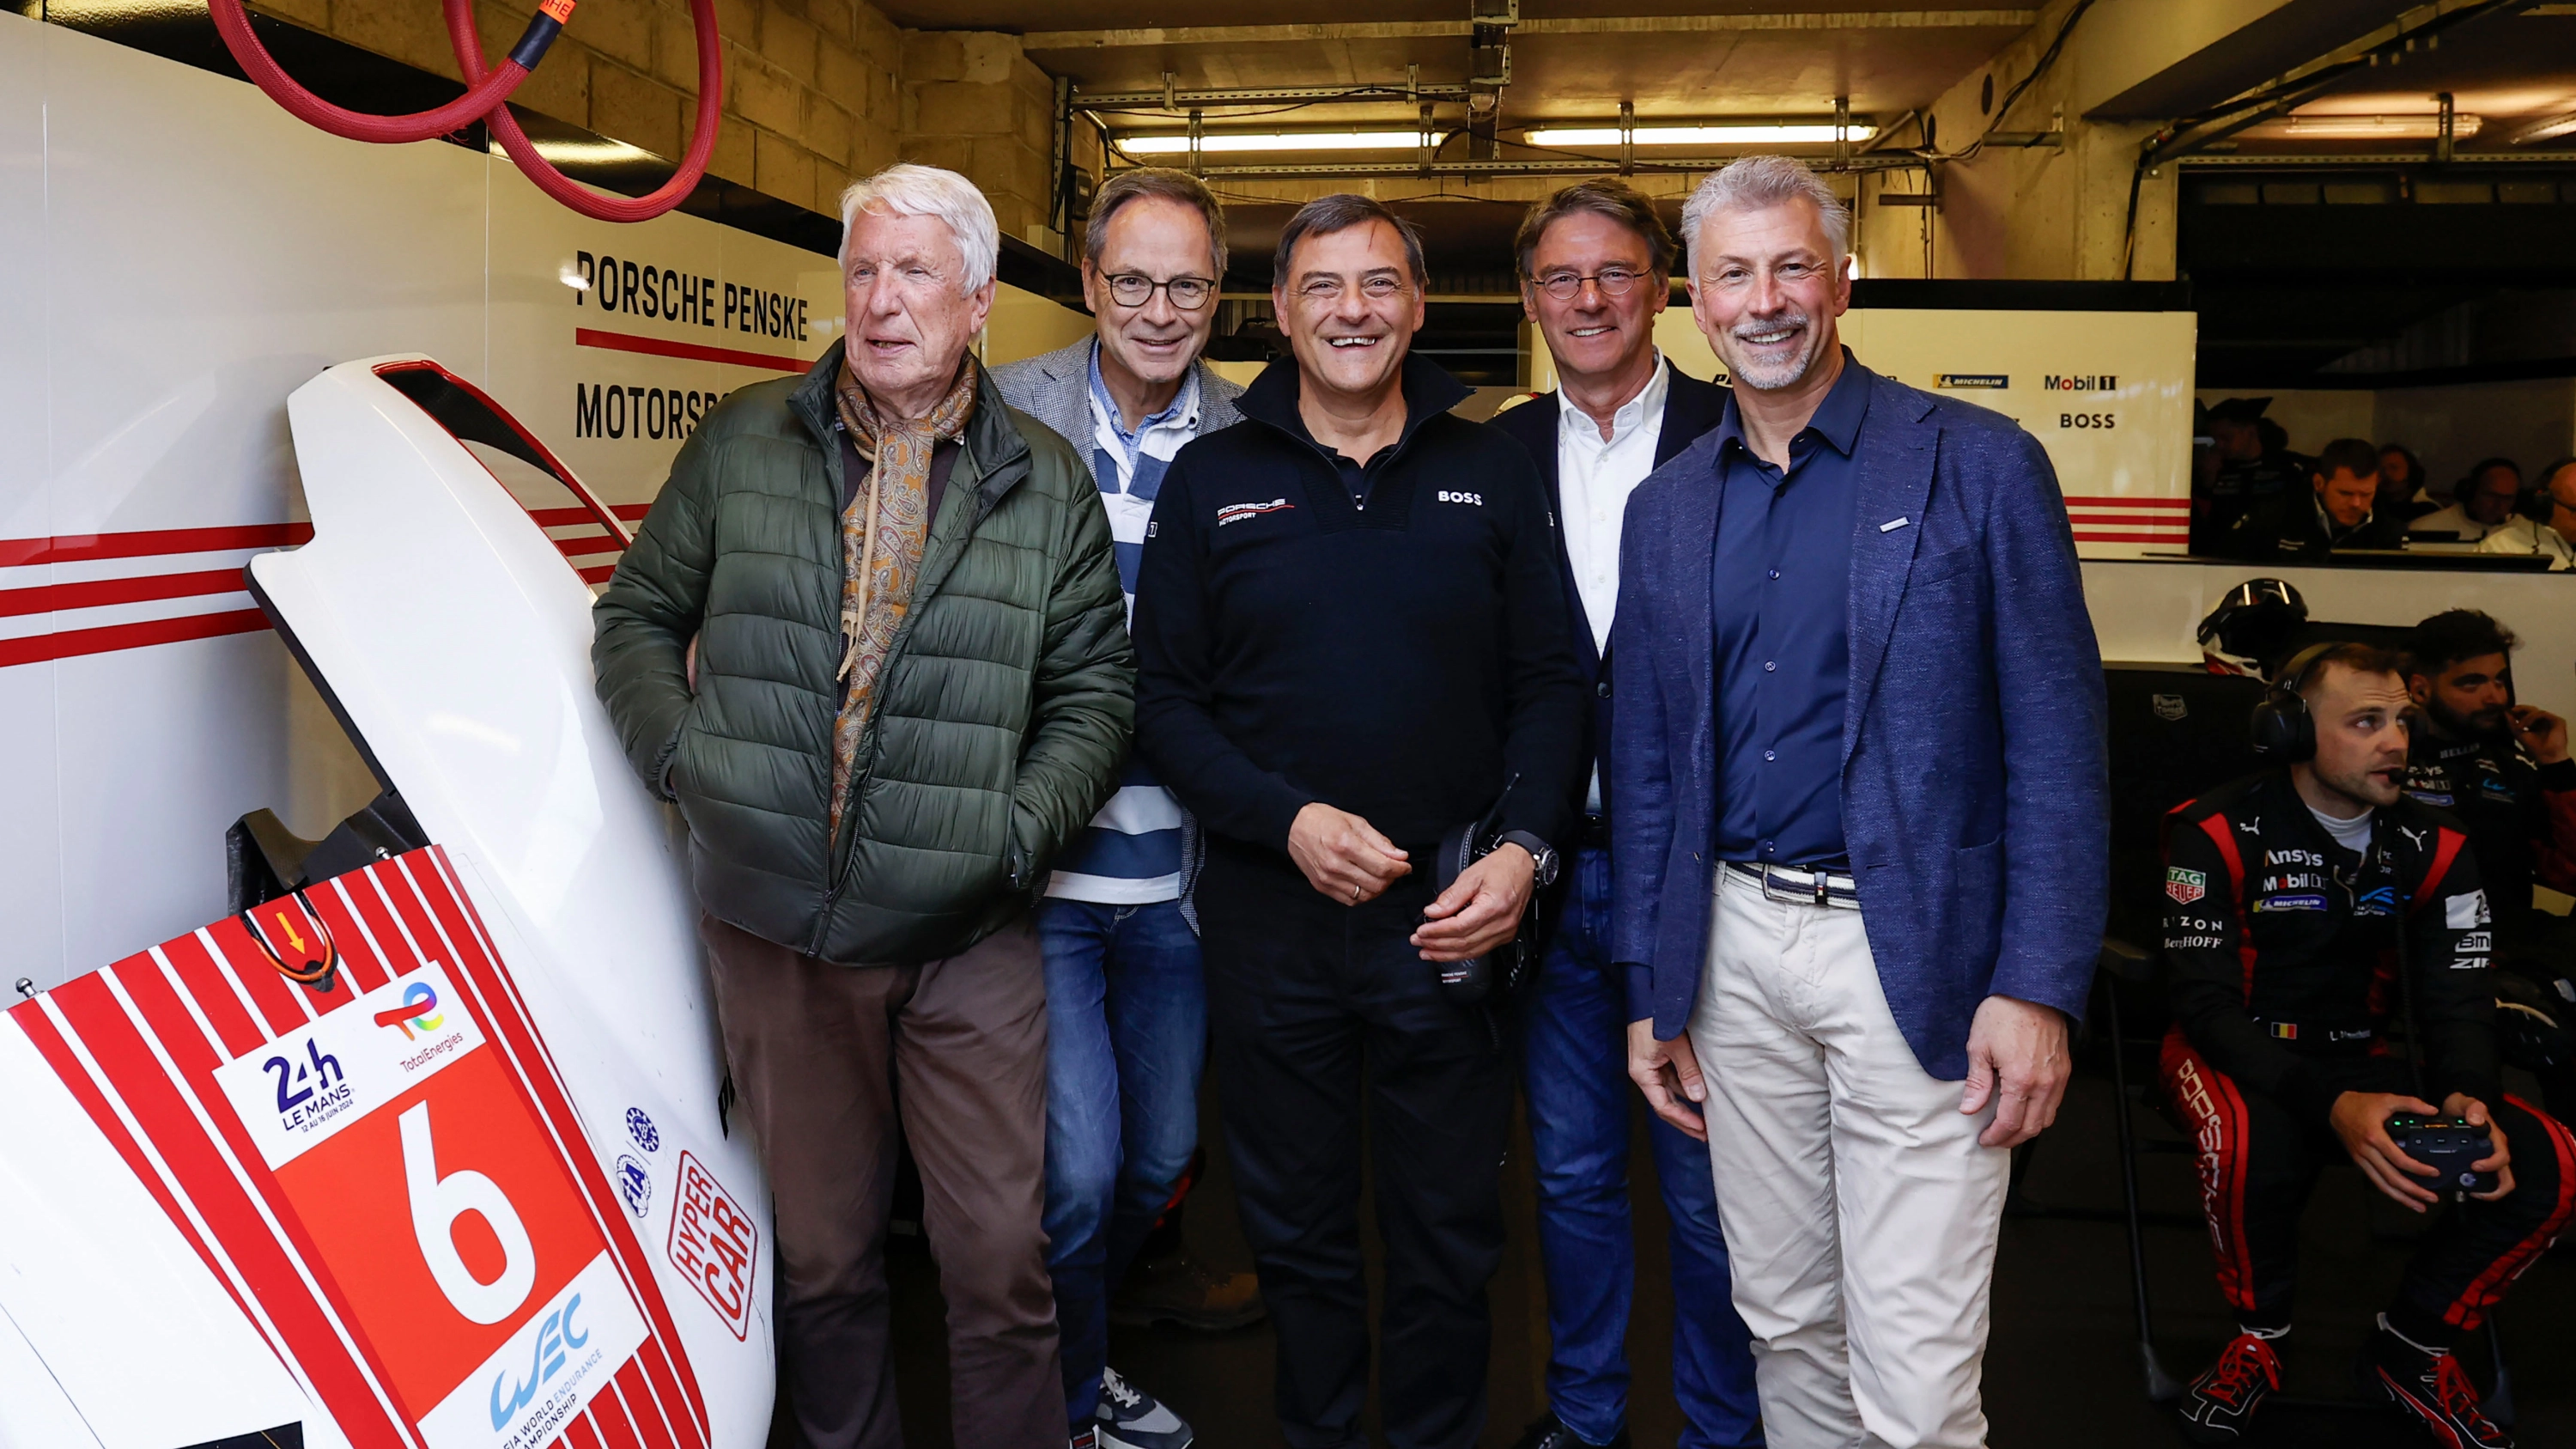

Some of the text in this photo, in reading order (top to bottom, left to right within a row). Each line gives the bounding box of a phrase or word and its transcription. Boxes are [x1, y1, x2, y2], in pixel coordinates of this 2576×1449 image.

[576, 250, 808, 342] PORSCHE PENSKE
[1953, 378, 2003, 387] MICHELIN
[2044, 374, 2116, 391] Mobil 1
[2060, 414, 2116, 429] BOSS
[1218, 498, 1286, 517] PORSCHE
[1438, 490, 1483, 506] BOSS
[2264, 849, 2324, 868] Ansys
[2167, 883, 2202, 902] HEUER
[2170, 869, 2202, 885] TAG
[2263, 873, 2309, 892] Mobil
[399, 1032, 464, 1073] TotalEnergies
[262, 1037, 344, 1114] 24h
[283, 1083, 350, 1131] LE MANS
[309, 1118, 319, 1129] AU
[325, 1106, 339, 1121] JUIN
[338, 1098, 354, 1111] 2024
[398, 1099, 537, 1325] 6
[676, 1166, 713, 1282] HYPER
[704, 1196, 750, 1320] CAR
[489, 1292, 589, 1433] WEC
[519, 1399, 554, 1437] WORLD
[552, 1348, 603, 1404] ENDURANCE
[520, 1392, 577, 1449] AMPIONSHIP
